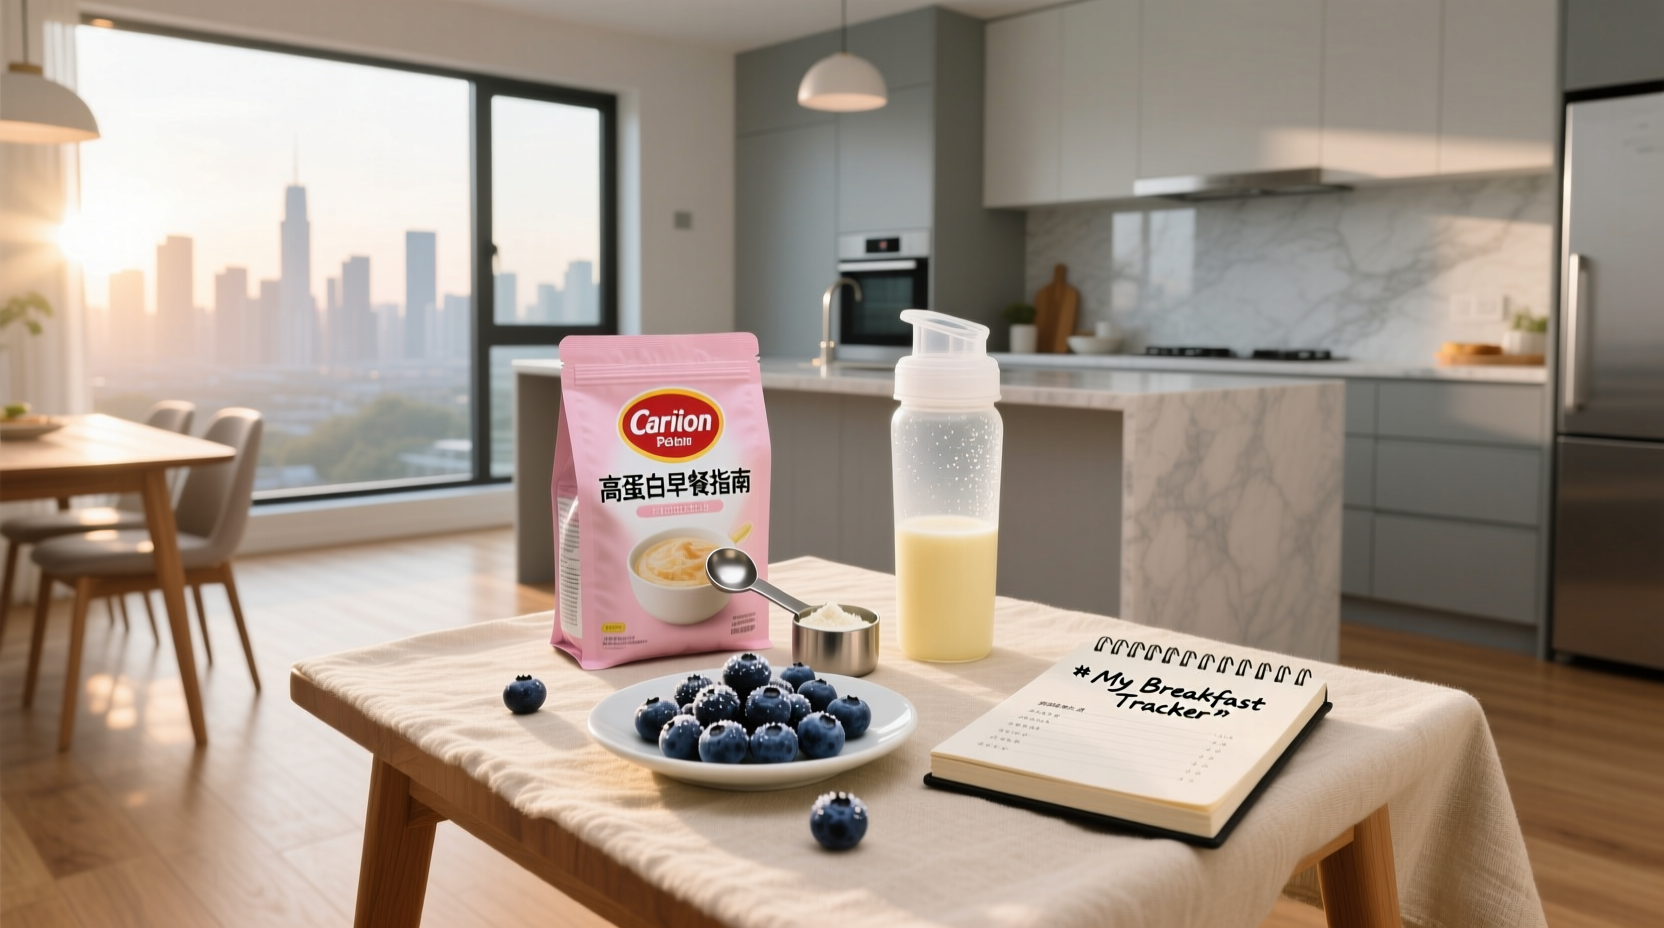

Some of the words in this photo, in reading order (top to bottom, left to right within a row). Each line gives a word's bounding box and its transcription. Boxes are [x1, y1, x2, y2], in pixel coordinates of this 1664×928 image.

[599, 467, 751, 504] 高蛋白早餐指南
[1091, 671, 1134, 693] My
[1140, 677, 1266, 711] Breakfast
